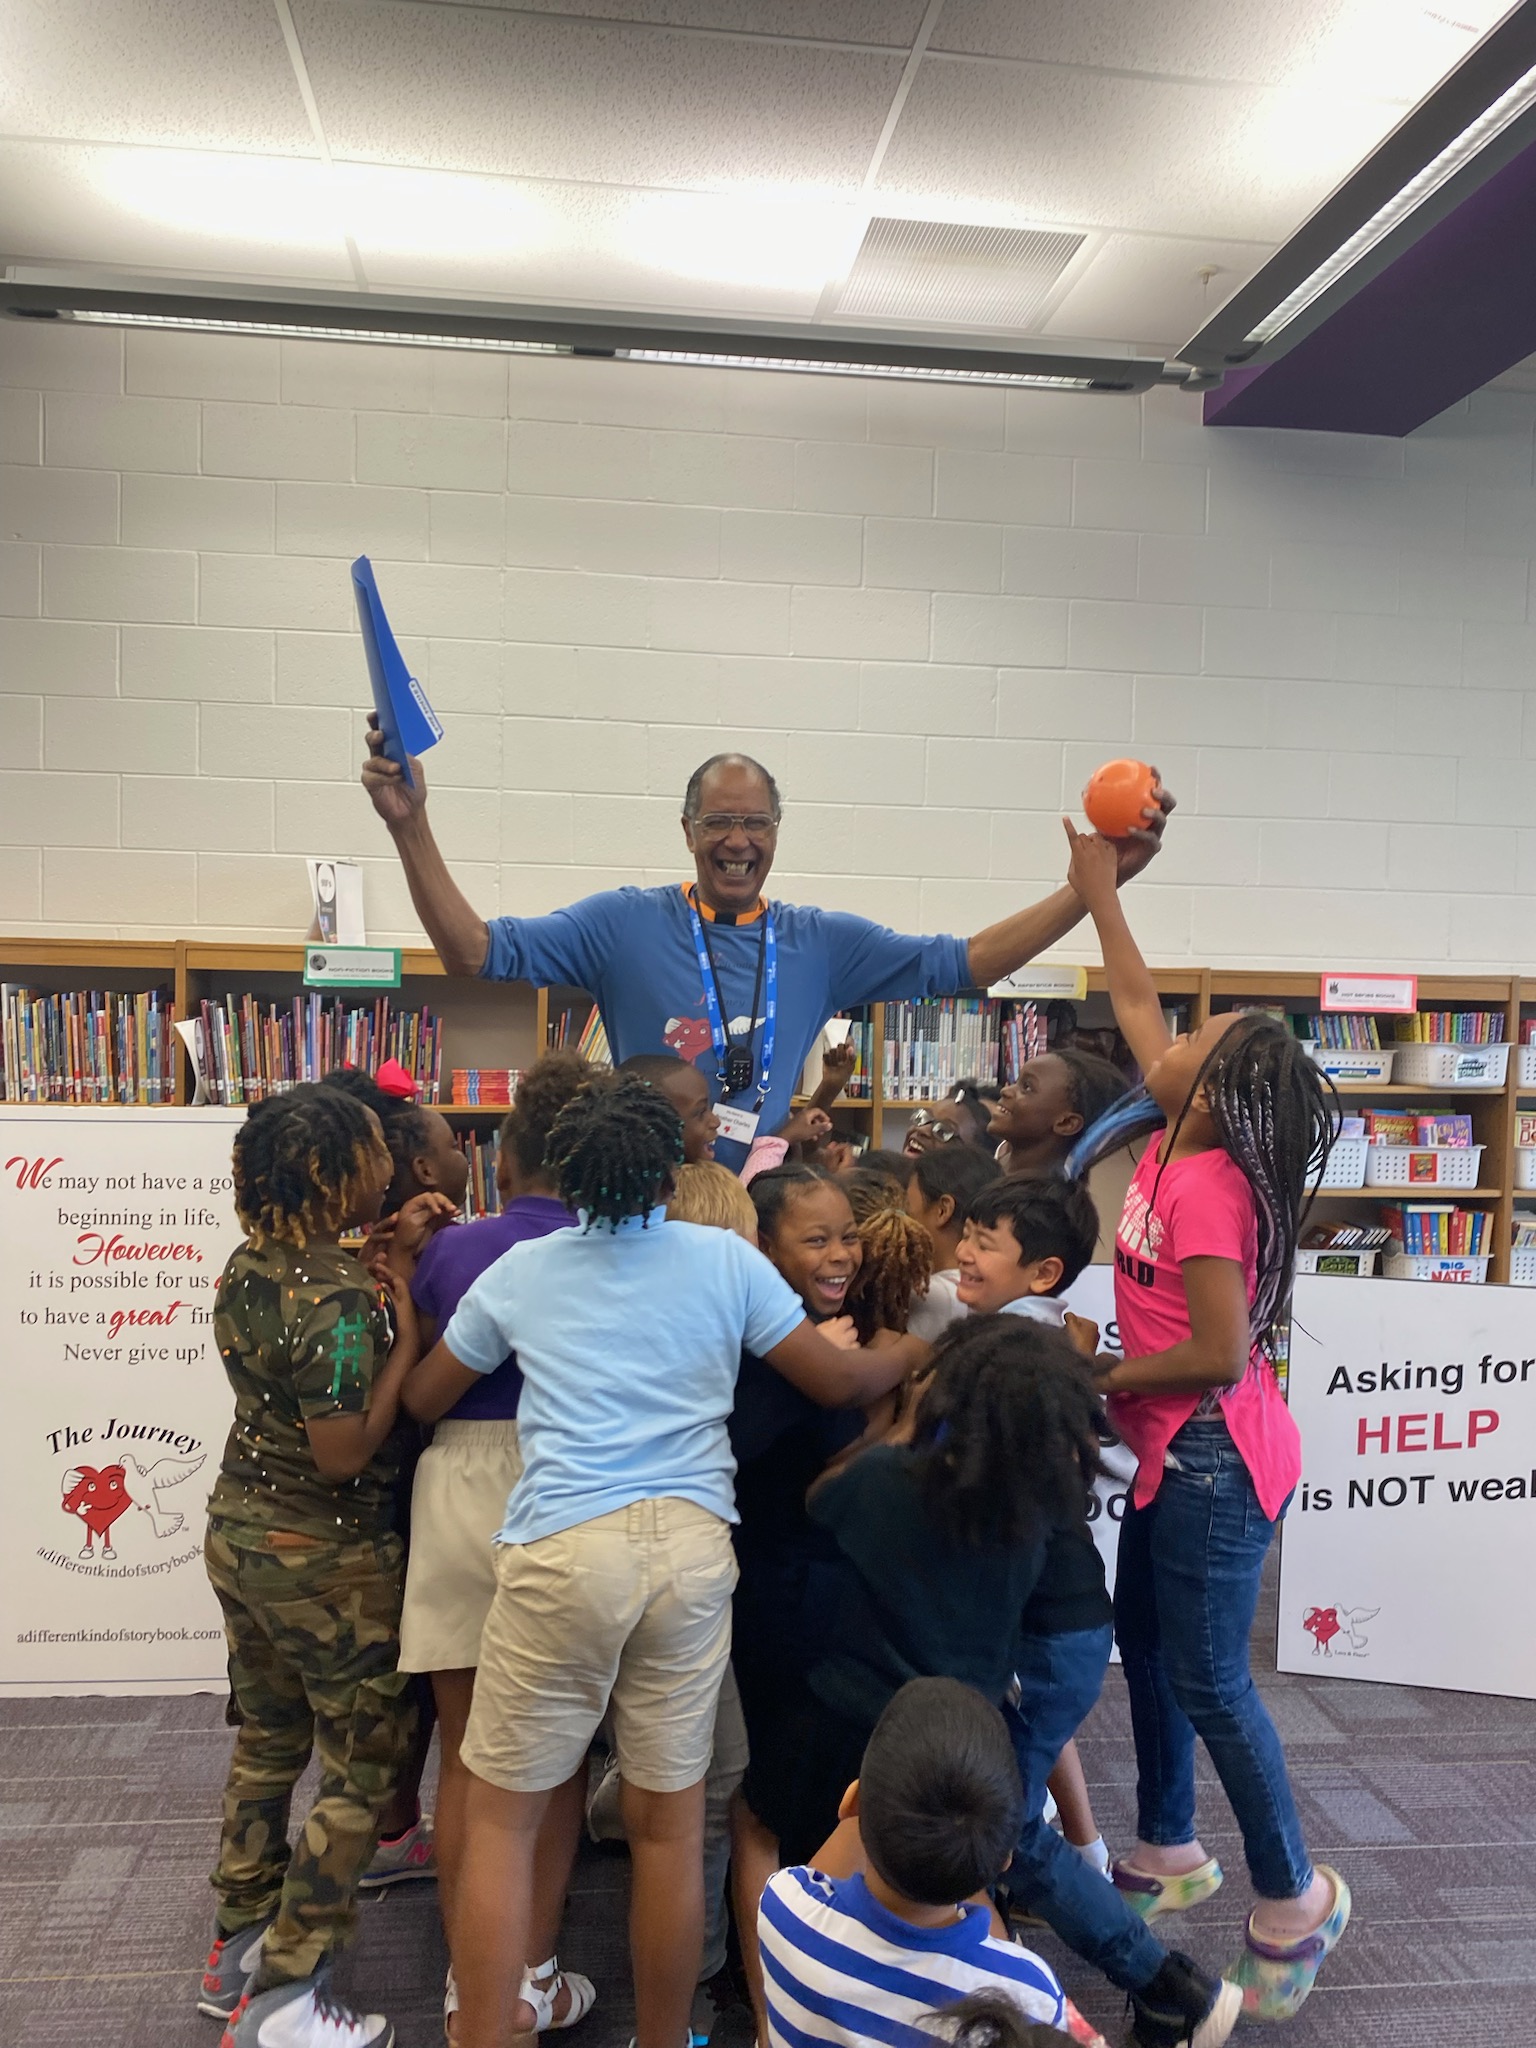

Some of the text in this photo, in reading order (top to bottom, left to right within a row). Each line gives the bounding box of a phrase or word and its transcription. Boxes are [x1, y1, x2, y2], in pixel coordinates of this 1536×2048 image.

[5, 1156, 234, 1194] We may not have a go
[58, 1208, 221, 1229] beginning in life,
[72, 1233, 203, 1266] However,
[1116, 1246, 1155, 1288] RLD
[1440, 1261, 1465, 1270] BIG
[29, 1271, 43, 1288] it
[48, 1271, 64, 1288] is
[70, 1271, 148, 1292] possible
[155, 1270, 183, 1288] for
[189, 1276, 209, 1288] us
[1431, 1269, 1473, 1282] NATE
[20, 1300, 215, 1339] to have a great fin
[63, 1343, 205, 1364] Never give up!
[1326, 1355, 1536, 1395] Asking for
[46, 1418, 202, 1456] The Journey
[1357, 1409, 1500, 1455] HELP
[1301, 1470, 1536, 1511] is NOT wea
[17, 1628, 221, 1643] adifferentkindofstorybook.com
